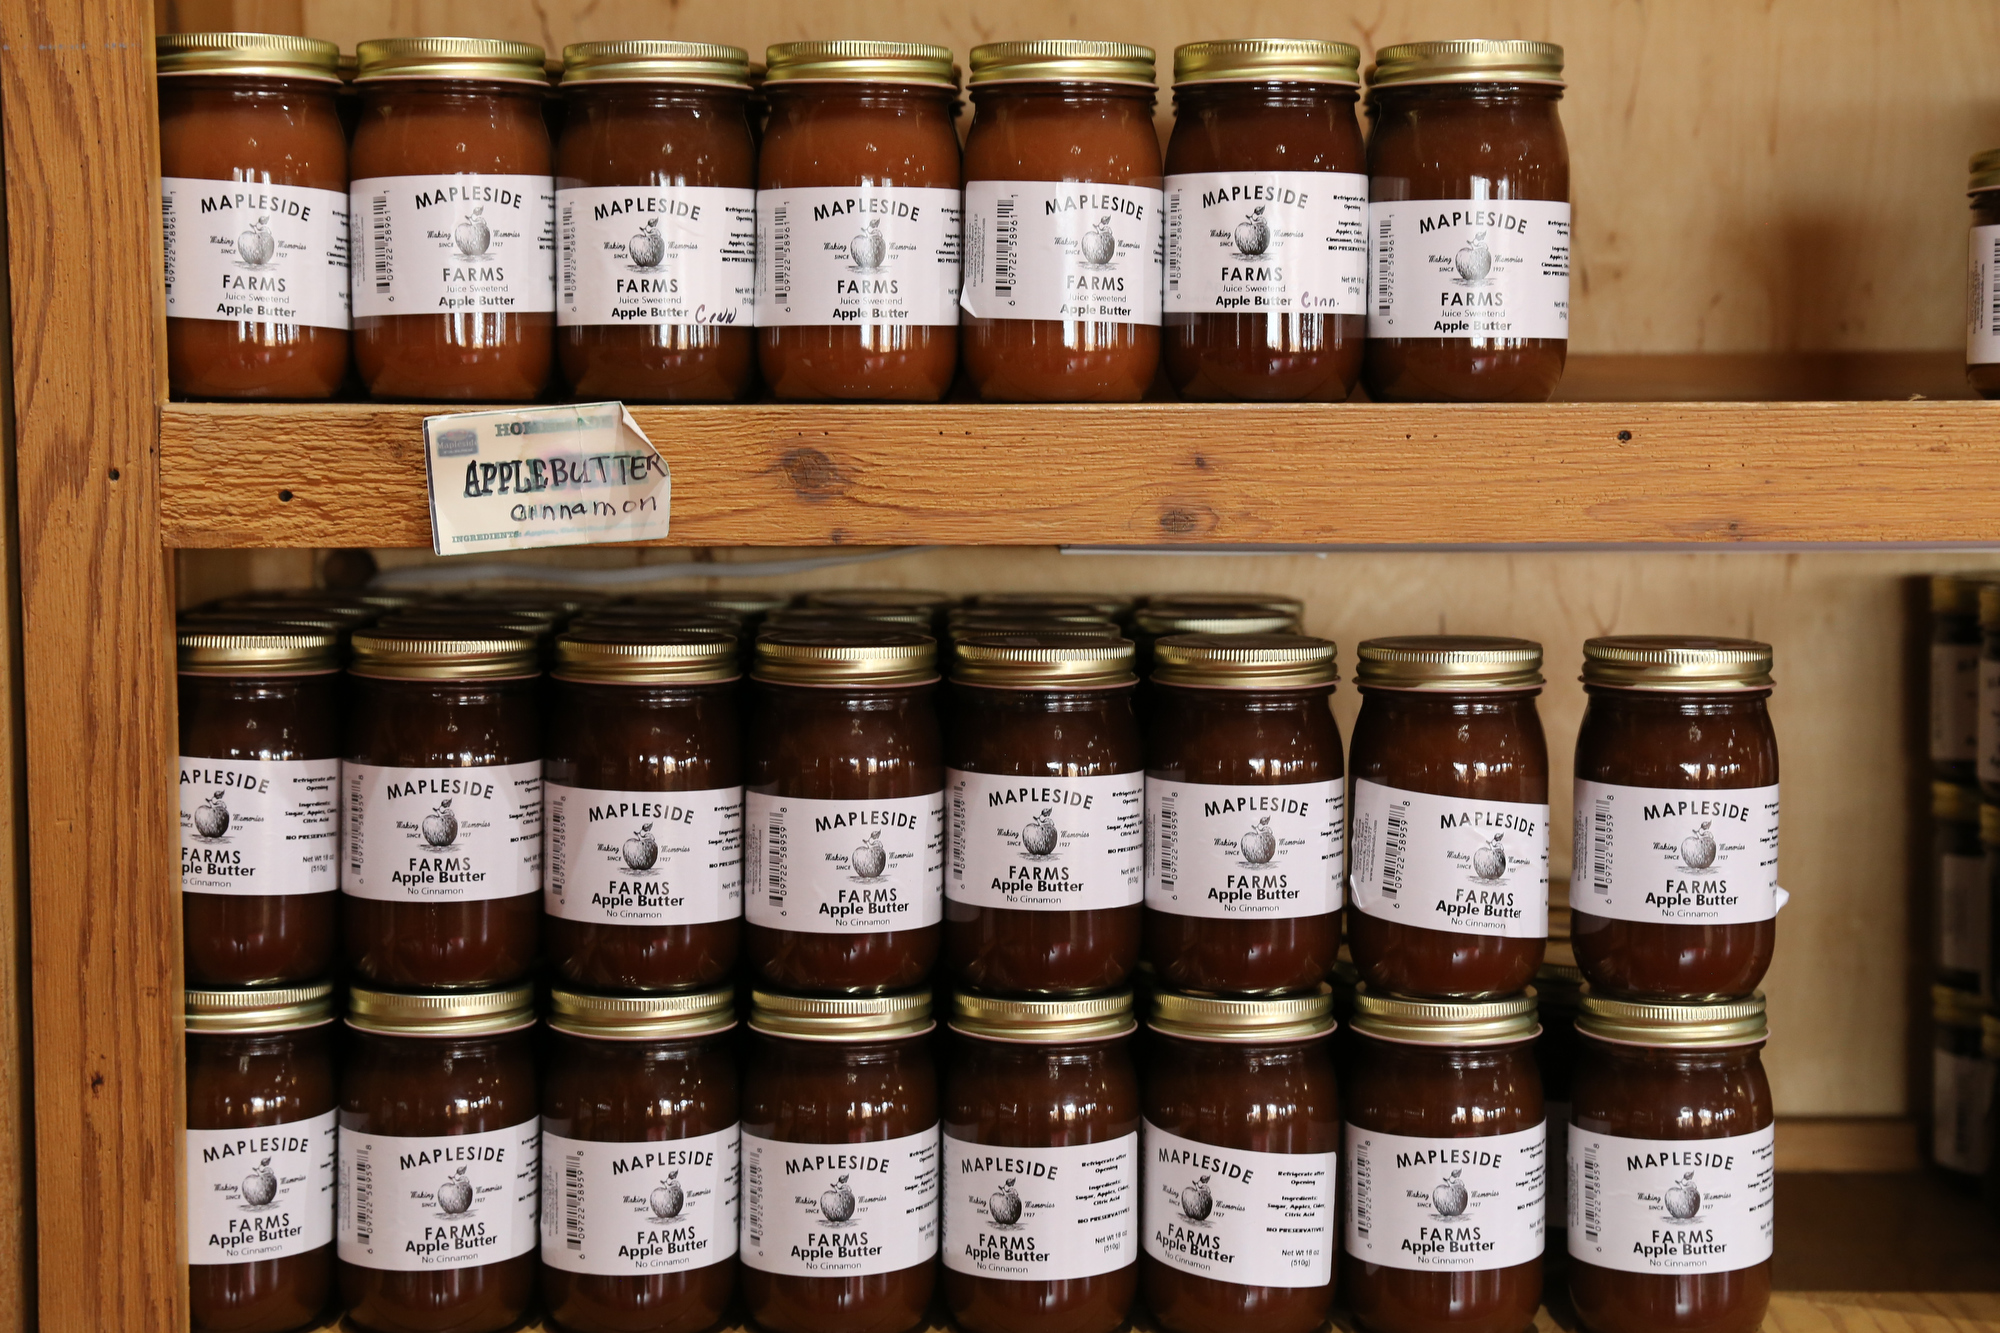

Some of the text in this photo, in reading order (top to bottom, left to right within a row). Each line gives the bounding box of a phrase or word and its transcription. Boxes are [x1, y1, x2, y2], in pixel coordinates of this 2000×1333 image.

[416, 187, 522, 210] MAPLESIDE
[1202, 186, 1308, 209] MAPLESIDE
[201, 194, 311, 222] MAPLESIDE
[594, 198, 701, 221] MAPLESIDE
[814, 199, 920, 222] MAPLESIDE
[1046, 195, 1143, 220] MAPLESIDE
[1419, 211, 1527, 234] MAPLESIDE
[443, 267, 504, 282] FARMS
[1221, 267, 1283, 281] FARMS
[223, 275, 286, 292] FARMS
[446, 284, 509, 293] Juice Sweetend
[616, 279, 678, 293] FARMS
[837, 280, 898, 294] FARMS
[1067, 276, 1124, 291] FARMS
[1246, 285, 1286, 293] Sweetend
[225, 293, 246, 302] Juice
[439, 295, 515, 308] Apple Butter
[619, 296, 682, 304] Juice Sweetend
[840, 297, 903, 305] Juice Sweetend
[1216, 296, 1292, 308] Apple Butter
[1441, 292, 1503, 306] FARMS
[217, 304, 296, 318] Apple Butter
[612, 308, 689, 319] Apple Butter
[833, 308, 908, 320] Apple Butter
[1060, 304, 1131, 316] Apple Butter
[1434, 321, 1512, 333] Apple Butter
[180, 769, 269, 794] APLESIDE
[387, 779, 494, 800] MAPLESIDE
[989, 788, 1093, 810] MAPLESIDE
[589, 803, 694, 824] MAPLESIDE
[1204, 797, 1309, 817] MAPLESIDE
[1644, 801, 1749, 822] MAPLESIDE
[232, 814, 264, 822] Memories
[396, 821, 419, 830] Making
[815, 811, 917, 832] MAPLESIDE
[1440, 812, 1535, 837] MAPLESIDE
[182, 848, 241, 864] FARMS
[1394, 820, 1409, 888] 09722 58959
[182, 861, 255, 876] ple Butter
[409, 858, 471, 871] FARMS
[392, 871, 486, 886] Apple Butter
[1009, 866, 1069, 880] FARMS
[190, 878, 231, 888] Cinnamon
[609, 881, 669, 895] FARMS
[991, 878, 1084, 894] Apple Butter
[1227, 875, 1287, 888] FARMS
[1666, 880, 1727, 894] FARMS
[408, 887, 464, 895] No Cinnamon
[838, 888, 897, 903] FARMS
[1208, 888, 1300, 903] Apple Butter
[1456, 889, 1514, 906] FARMS
[592, 893, 685, 908] Apple Butter
[1020, 895, 1062, 903] Cinnamon
[1645, 892, 1738, 907] Apple Butter
[620, 910, 662, 918] Cinnamon
[819, 902, 909, 918] Apple Butter
[1436, 900, 1522, 918] Apple Butter
[1662, 909, 1718, 918] No Cinnamon
[850, 918, 890, 926] Cinnamon
[1451, 917, 1506, 929] No Cinnamon
[203, 1137, 308, 1163] MAPLESIDE
[400, 1146, 505, 1170] MAPLESIDE
[612, 1151, 713, 1175] MAPLESIDE
[786, 1155, 890, 1175] MAPLESIDE
[1397, 1150, 1502, 1168] MAPLESIDE
[1627, 1152, 1734, 1171] MAPLESIDE
[961, 1157, 1058, 1180] MAPLESIDE
[1158, 1148, 1253, 1184] MAPLESIDE
[229, 1213, 290, 1233] FARMS
[209, 1226, 302, 1248] Apple Butter
[425, 1222, 485, 1240] FARMS
[637, 1226, 695, 1244] FARMS
[1168, 1223, 1220, 1249] FARMS
[1420, 1227, 1481, 1241] FARMS
[1652, 1230, 1713, 1244] FARMS
[405, 1234, 497, 1255] Apple Butter
[808, 1232, 868, 1246] FARMS
[979, 1234, 1035, 1250] FARMS
[618, 1239, 708, 1260] Apple Butter
[791, 1245, 882, 1261] Apple Butter
[965, 1244, 1050, 1262] Apple Butter
[1156, 1230, 1235, 1264] Apple Butter
[1401, 1239, 1495, 1255] Apple Butter
[1633, 1242, 1727, 1258] Apple Butter
[635, 1257, 689, 1268] No Cinnamon
[820, 1262, 861, 1270] Cinnamon
[977, 1262, 1028, 1273] No Cinnamon
[1165, 1250, 1211, 1271] No Cinnamon
[1291, 1259, 1310, 1267] (510g)
[1432, 1256, 1474, 1264] Cinnamon
[1664, 1259, 1707, 1267] Cinnamon
